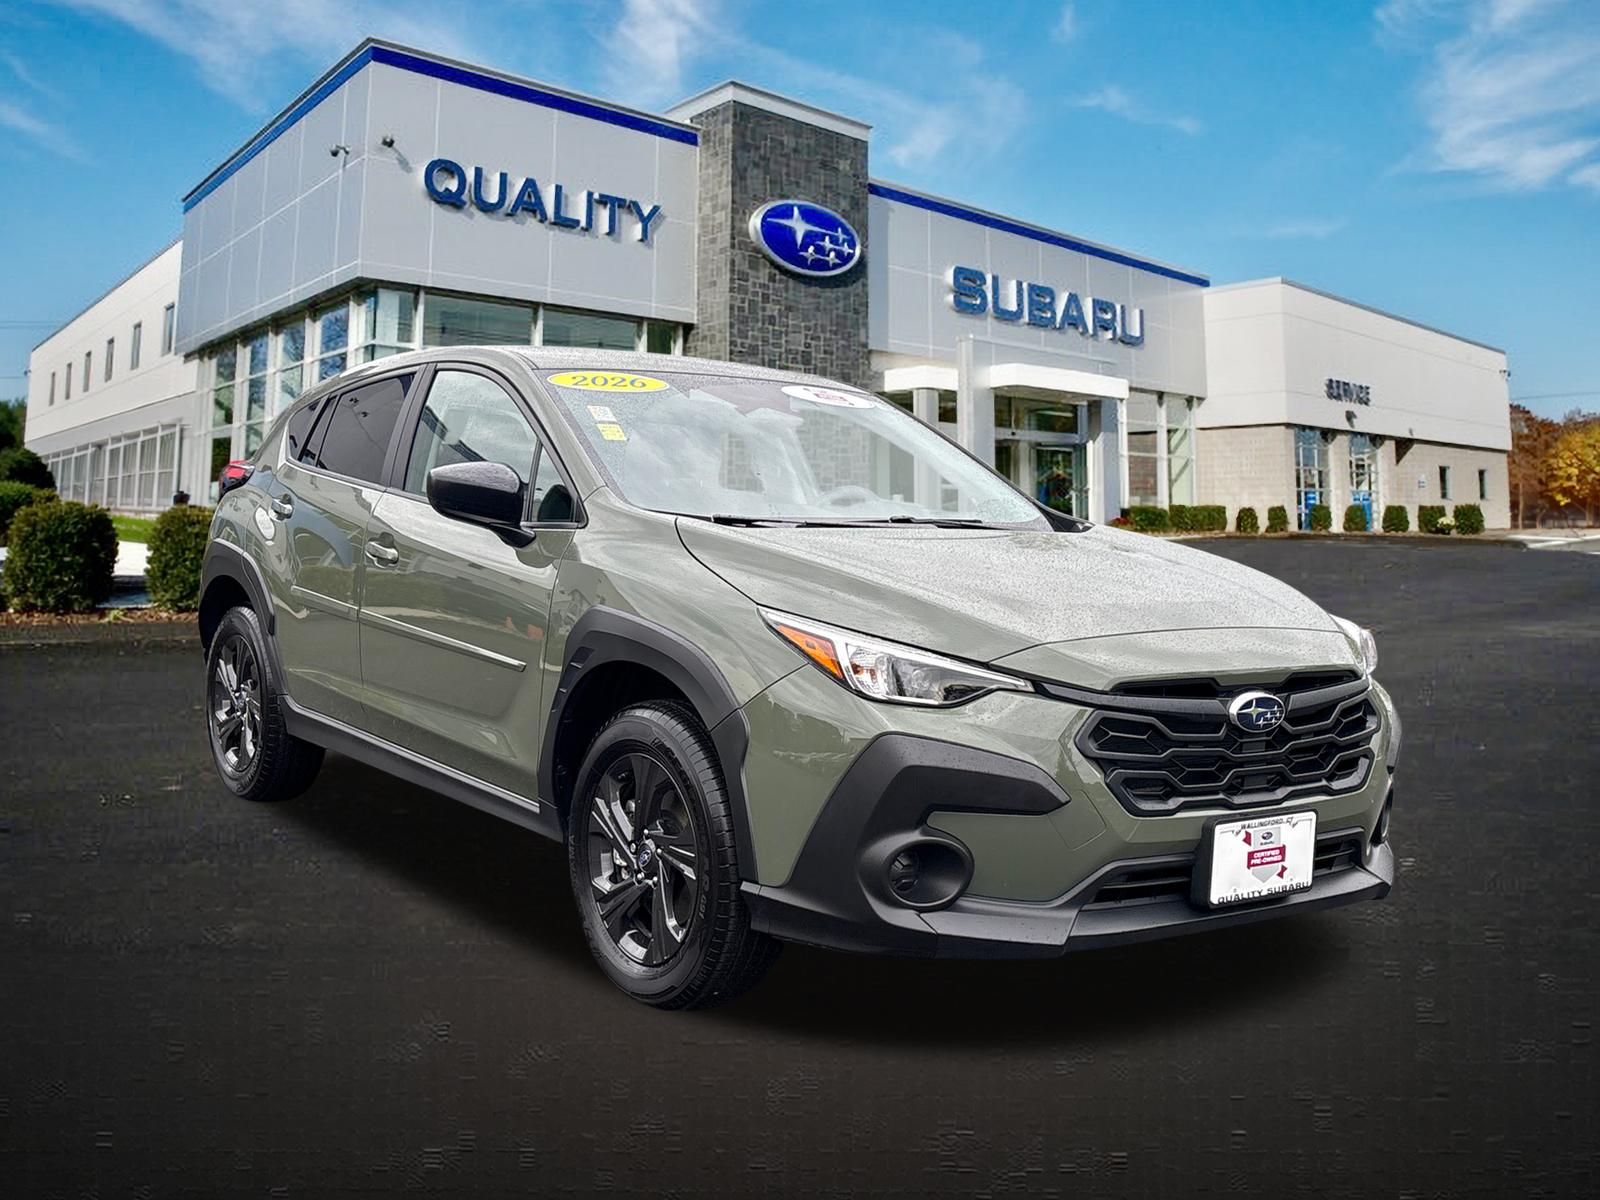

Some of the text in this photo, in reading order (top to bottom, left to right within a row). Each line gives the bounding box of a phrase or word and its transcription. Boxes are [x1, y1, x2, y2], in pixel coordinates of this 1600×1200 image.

[423, 158, 661, 243] QUALITY
[951, 265, 1145, 347] SUBARU
[571, 375, 646, 389] 2026
[1325, 378, 1371, 407] SERVICE
[1253, 849, 1280, 859] CERTIFIED
[1218, 881, 1309, 904] QUALITY SUBARU
